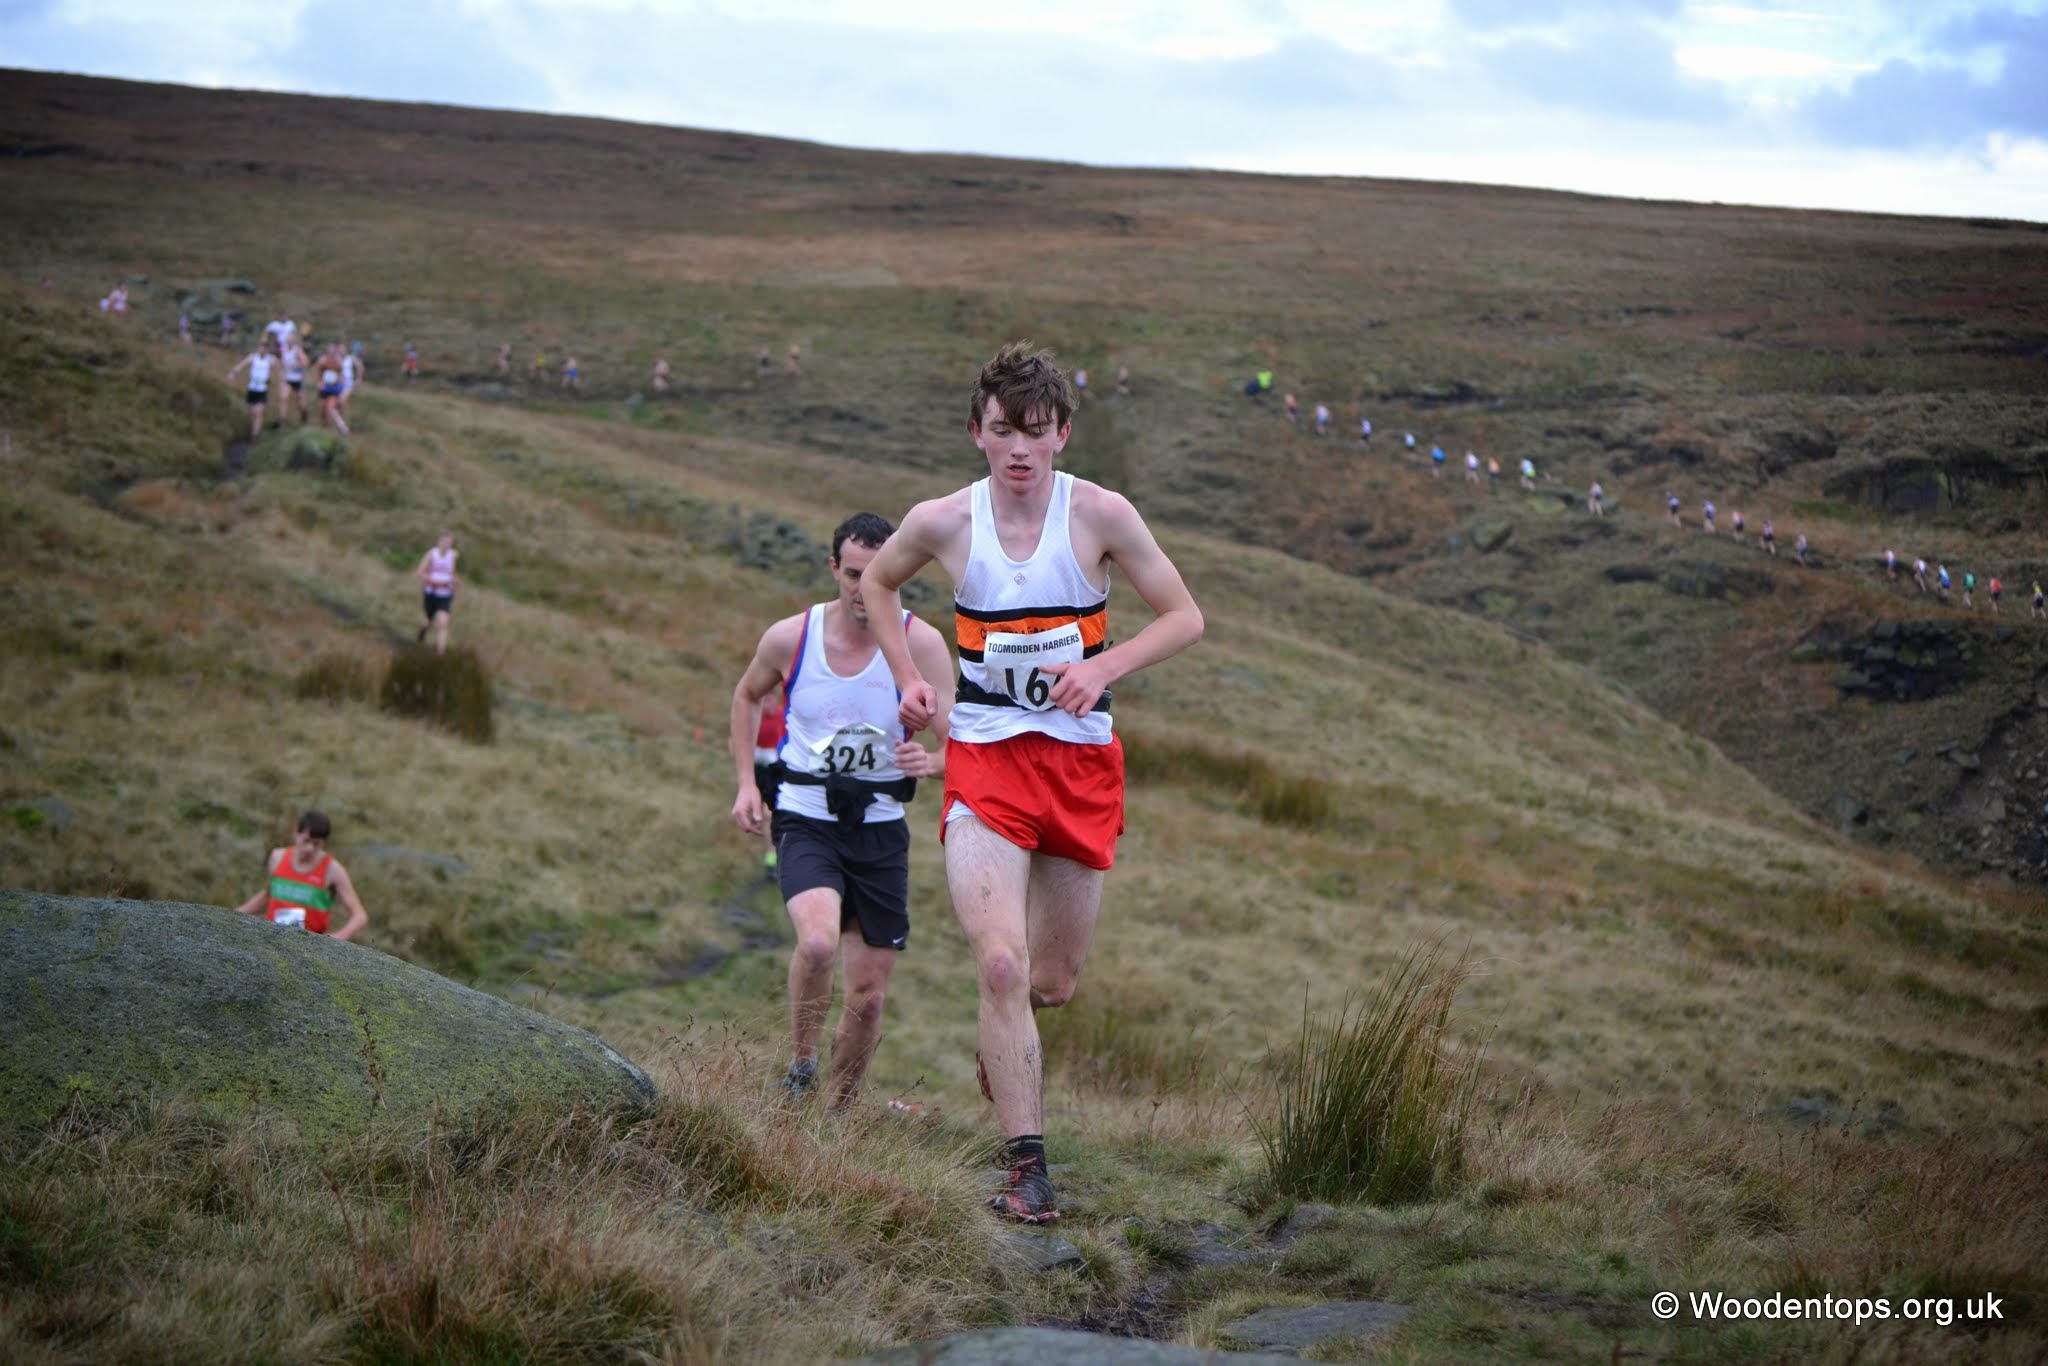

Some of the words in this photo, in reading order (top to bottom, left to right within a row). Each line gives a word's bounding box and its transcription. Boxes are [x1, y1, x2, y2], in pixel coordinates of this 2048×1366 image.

[988, 642, 1040, 655] TODMORDEN
[1042, 633, 1080, 652] HARRIERS
[1005, 667, 1065, 707] 16
[819, 742, 876, 774] 324
